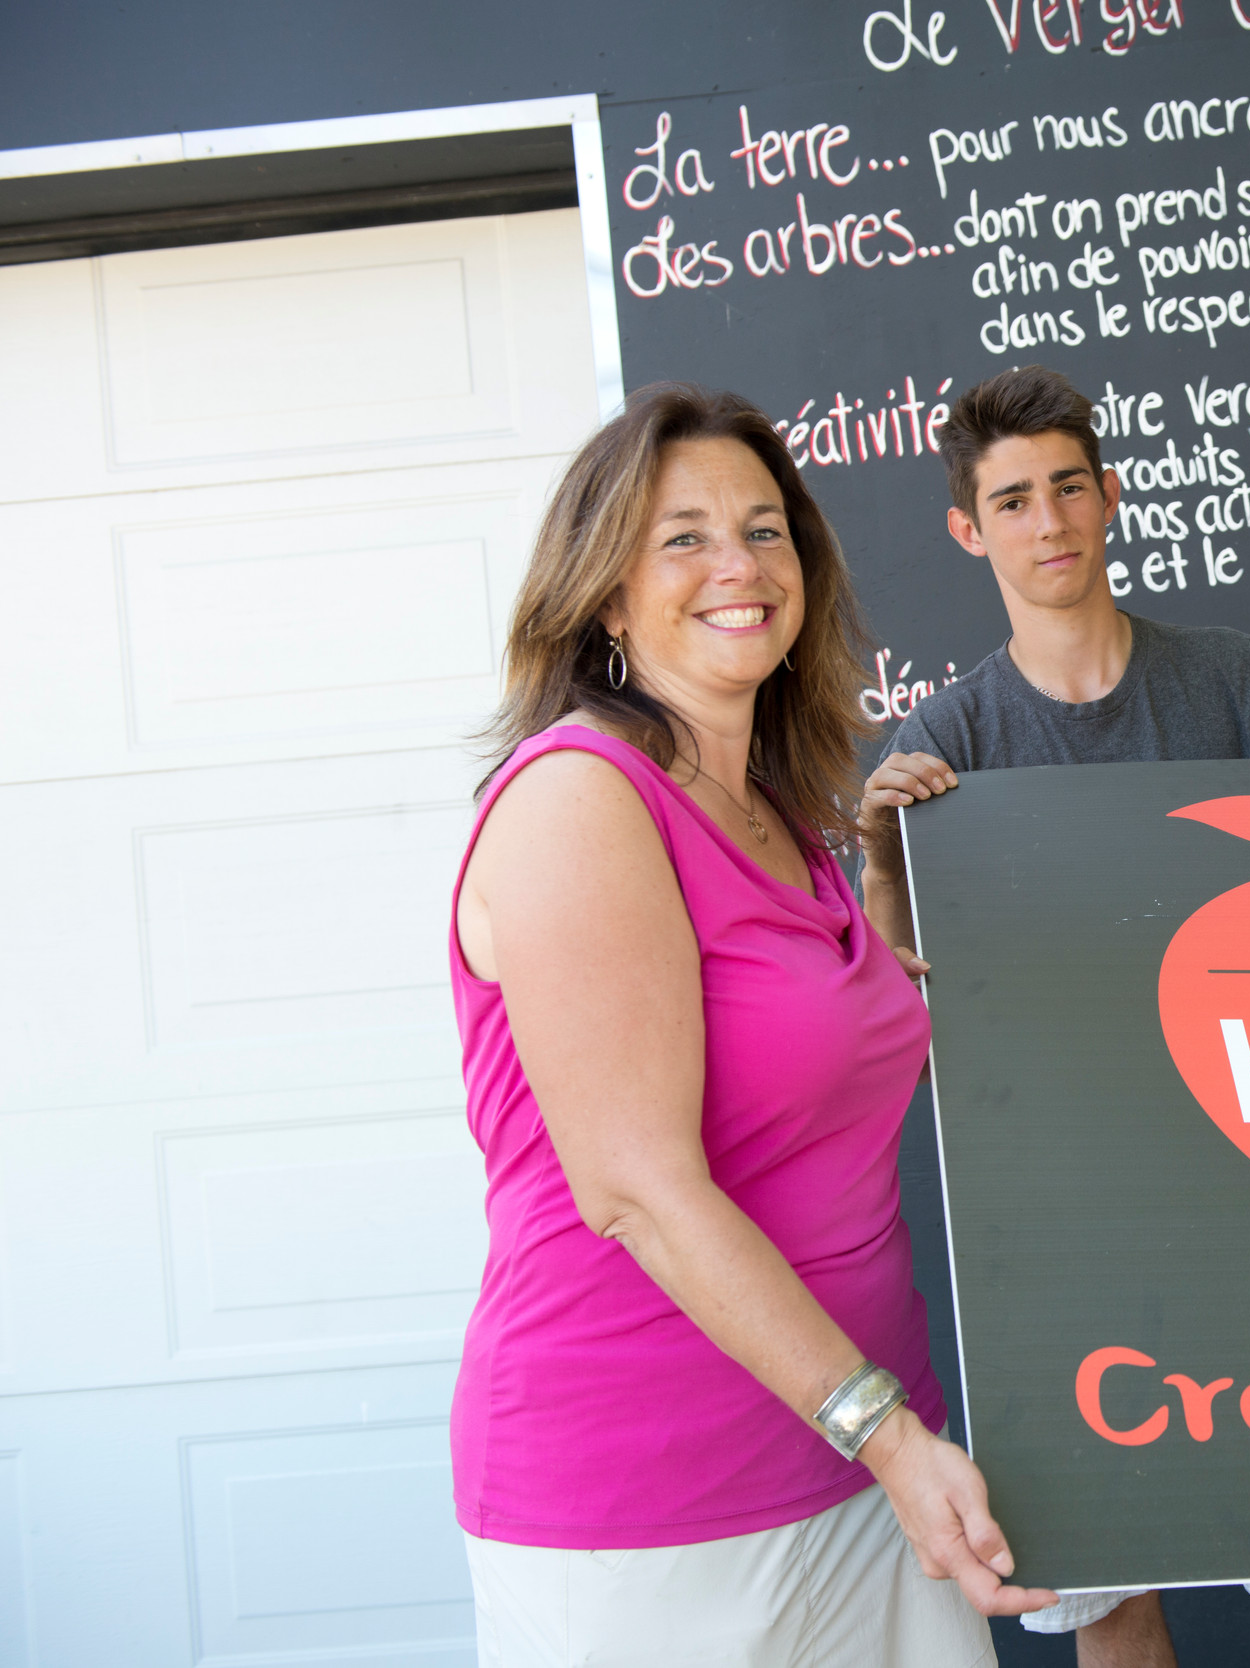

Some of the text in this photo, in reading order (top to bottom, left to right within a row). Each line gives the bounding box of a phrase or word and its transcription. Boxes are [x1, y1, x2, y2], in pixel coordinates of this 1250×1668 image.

[863, 0, 957, 71] Le
[623, 111, 715, 210] La
[730, 105, 909, 186] terre...
[929, 121, 1019, 199] pour
[1033, 106, 1128, 151] nous
[622, 215, 733, 297] Les
[954, 189, 1047, 247] dont
[1052, 198, 1103, 240] on
[1115, 165, 1228, 247] prend
[972, 244, 1059, 298] afin
[1067, 241, 1120, 289] de
[980, 302, 1086, 354] dans
[1095, 289, 1131, 337] le
[1089, 381, 1165, 437] otre
[1102, 432, 1245, 491] roduits
[1118, 501, 1190, 543] nos
[1141, 543, 1189, 593] et
[1203, 535, 1244, 587] le
